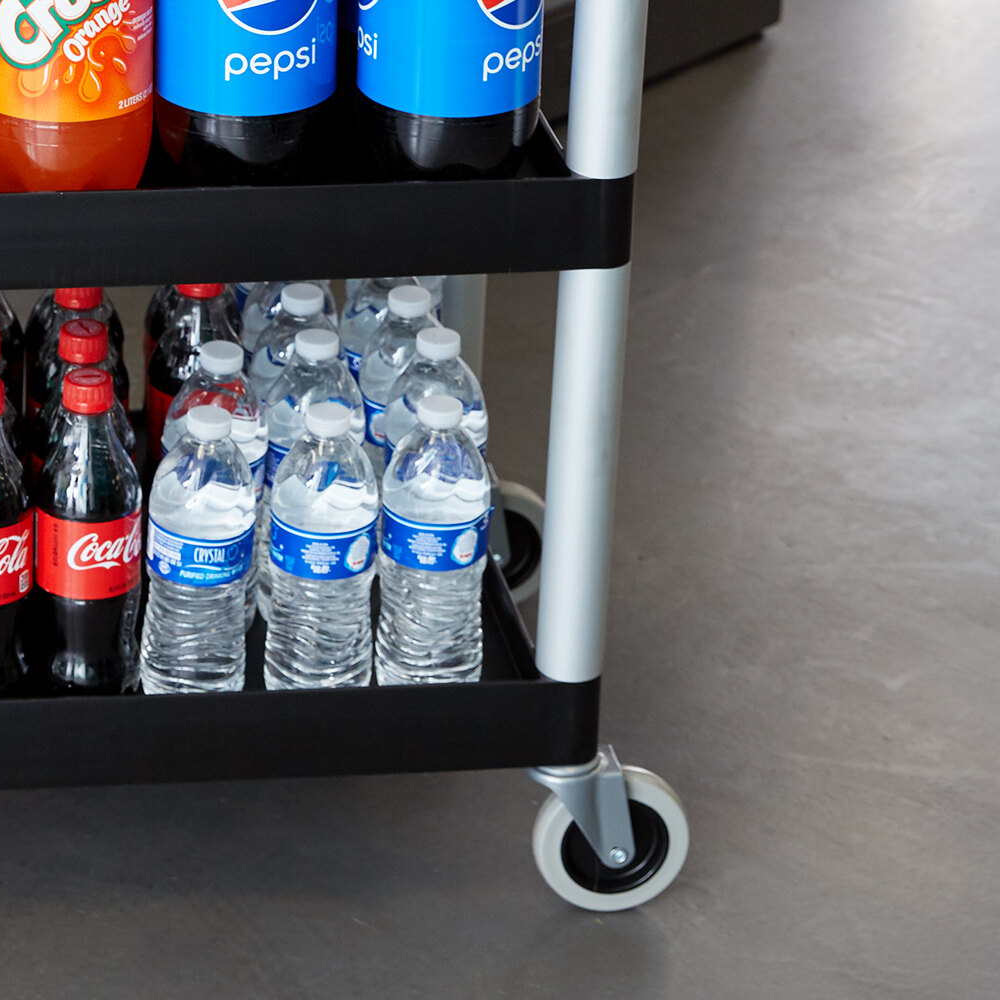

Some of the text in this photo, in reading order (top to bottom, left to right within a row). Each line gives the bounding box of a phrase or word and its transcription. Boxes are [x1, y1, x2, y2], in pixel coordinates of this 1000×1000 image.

[224, 38, 316, 81] pepsi
[358, 25, 378, 60] psi
[483, 33, 541, 82] peps
[118, 92, 143, 109] 2 LITERS
[193, 547, 226, 563] CRYSTAL
